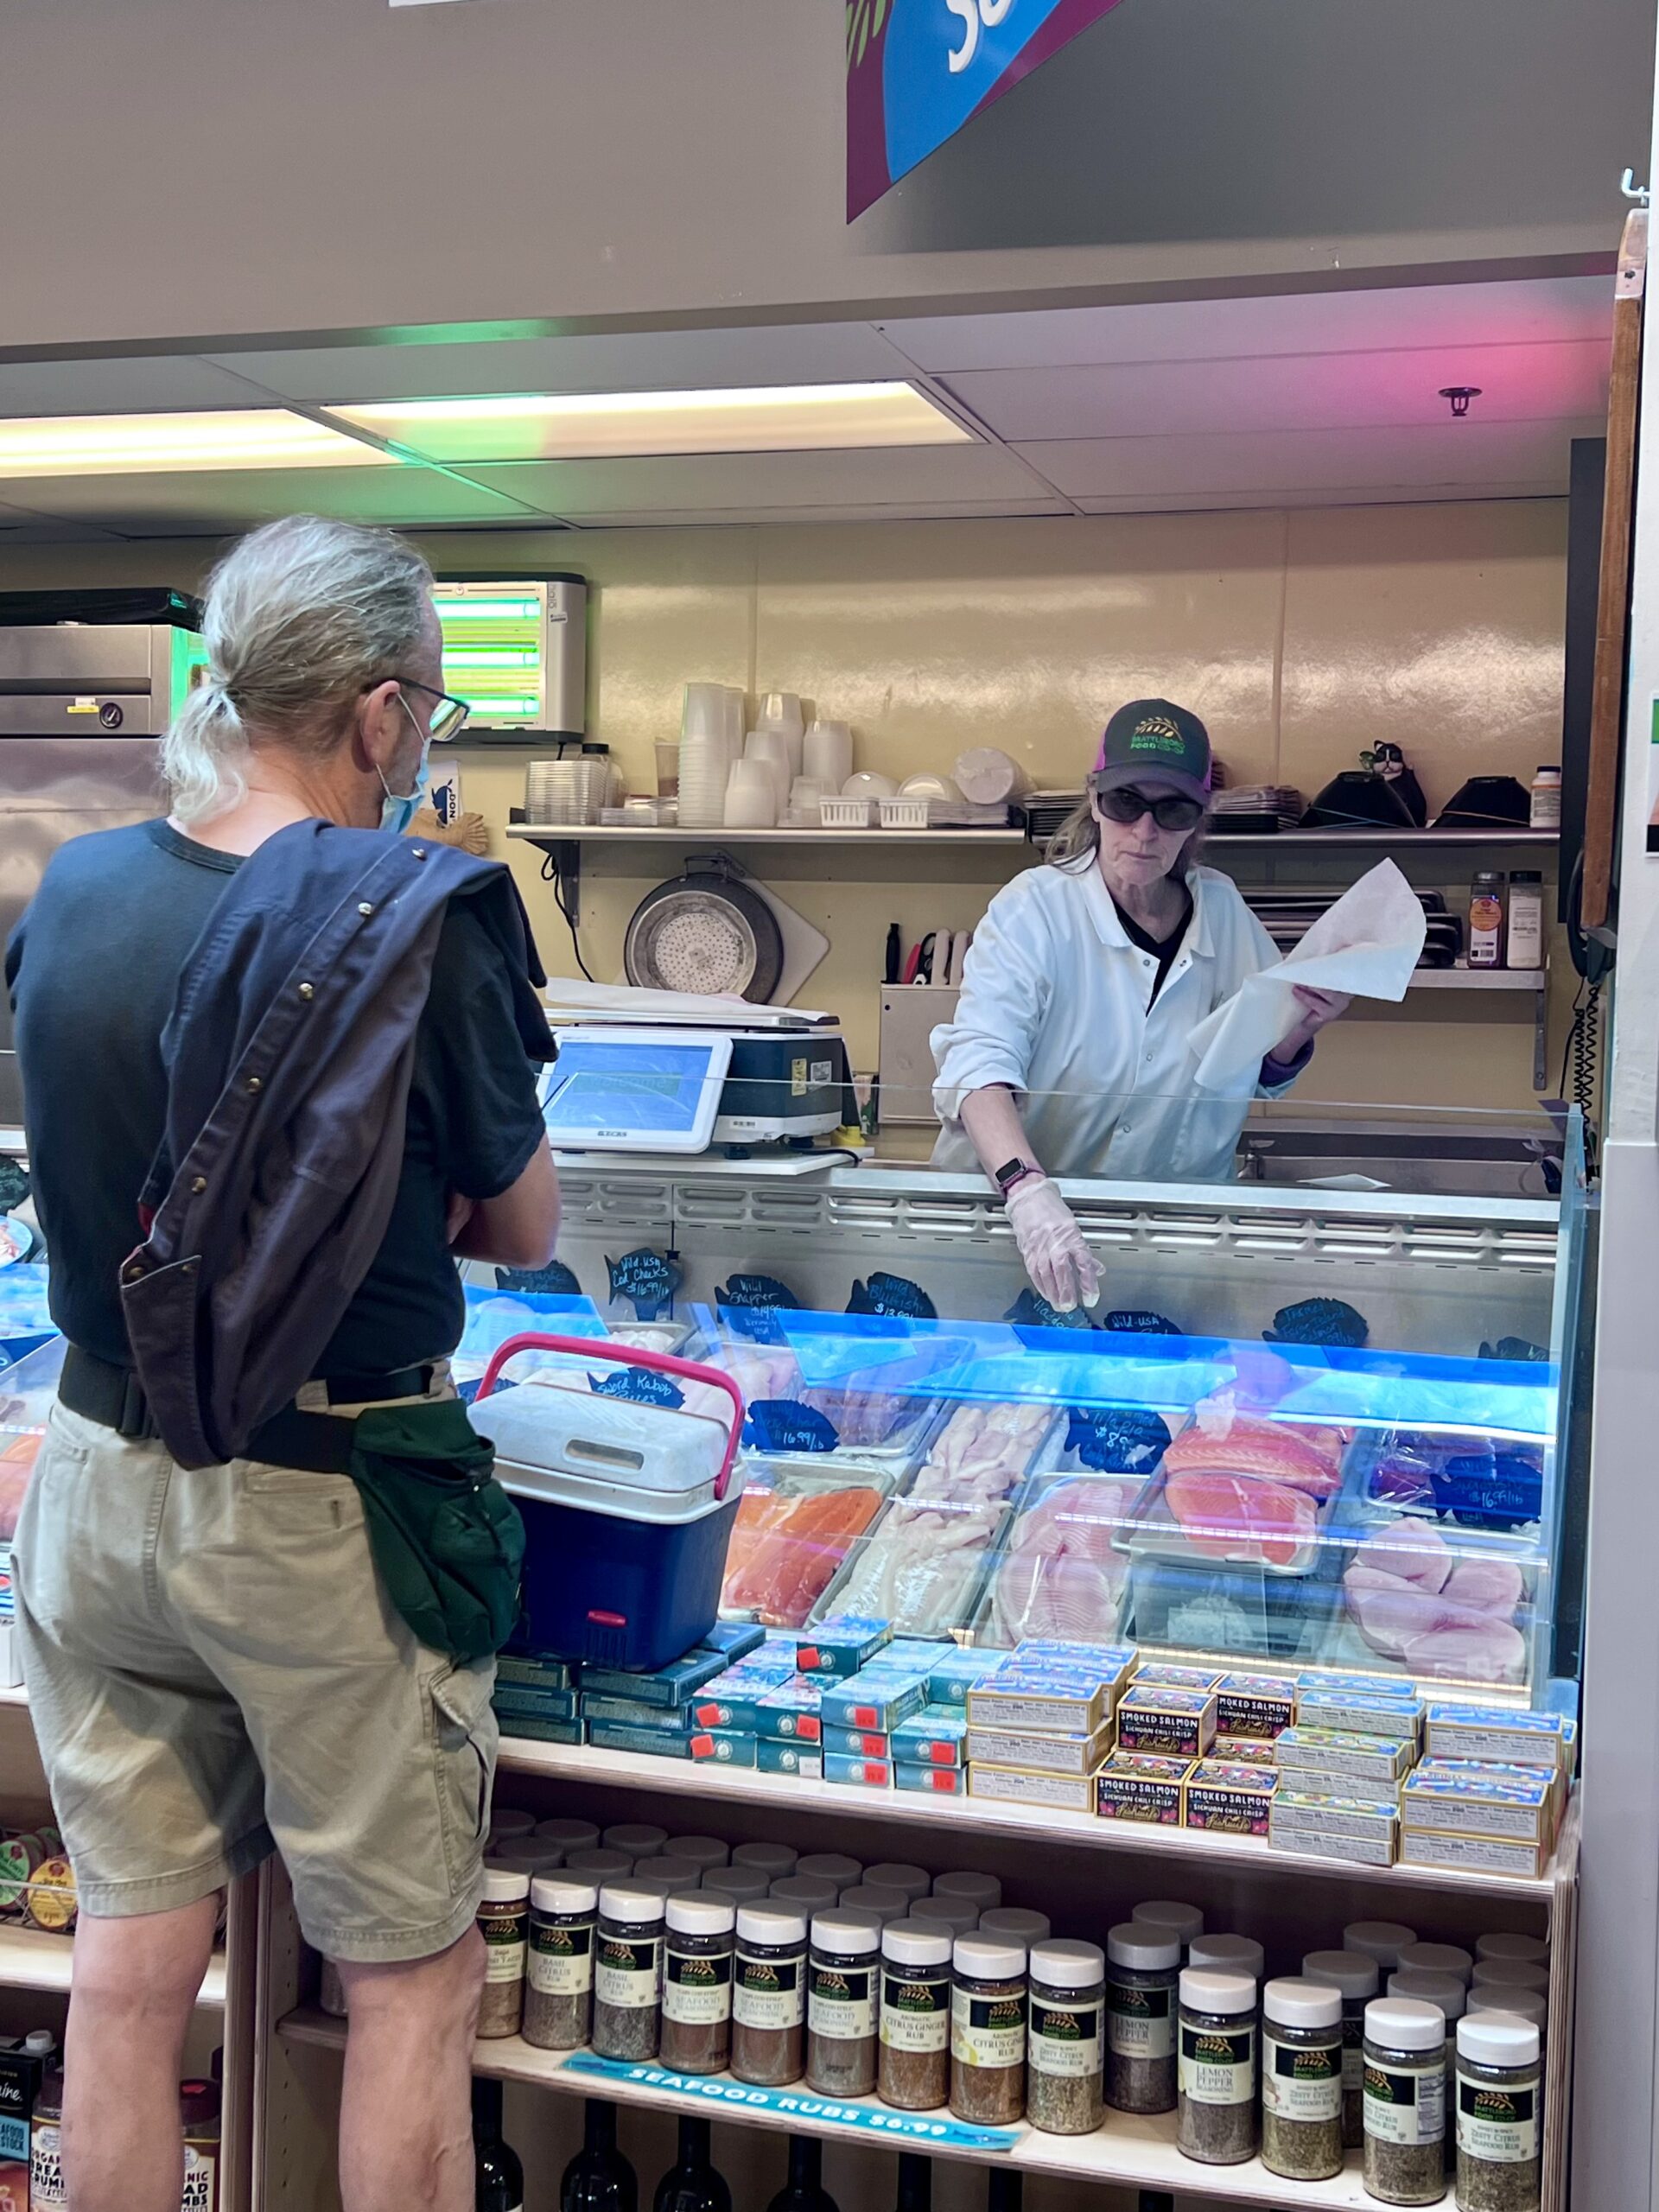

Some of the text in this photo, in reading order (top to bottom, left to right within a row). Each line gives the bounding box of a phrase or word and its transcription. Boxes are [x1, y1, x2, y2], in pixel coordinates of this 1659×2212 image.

[1219, 1697, 1289, 1714] MOKED SALMON
[1121, 1712, 1198, 1728] SMOKED SALMON
[1099, 1779, 1137, 1791] SMOKED
[1139, 1783, 1179, 1796] SALMON
[1189, 1789, 1270, 1807] SMOKED SALMON
[603, 1980, 634, 1992] CITRUS
[741, 1999, 784, 2010] SEAFOOD
[886, 2017, 945, 2031] CITRUS GINGER
[1116, 2018, 1149, 2030] LEMON
[906, 2031, 925, 2039] RUB
[1116, 2027, 1149, 2038] PEPPER
[973, 2038, 1005, 2049] CITRUS
[998, 2048, 1015, 2057] RUB
[1058, 2050, 1084, 2059] CITRUS
[1197, 2064, 1234, 2077] LEMON
[1197, 2075, 1234, 2087] PEPPER
[1289, 2089, 1336, 2099] ZESTY CITRUS
[628, 2069, 947, 2136] SEAFOOD RUBS $6.99
[0, 2123, 24, 2138] AFOOD
[1471, 2129, 1521, 2143] ZESTY CITRUS
[1471, 2138, 1520, 2151] SEAFOOD RUB
